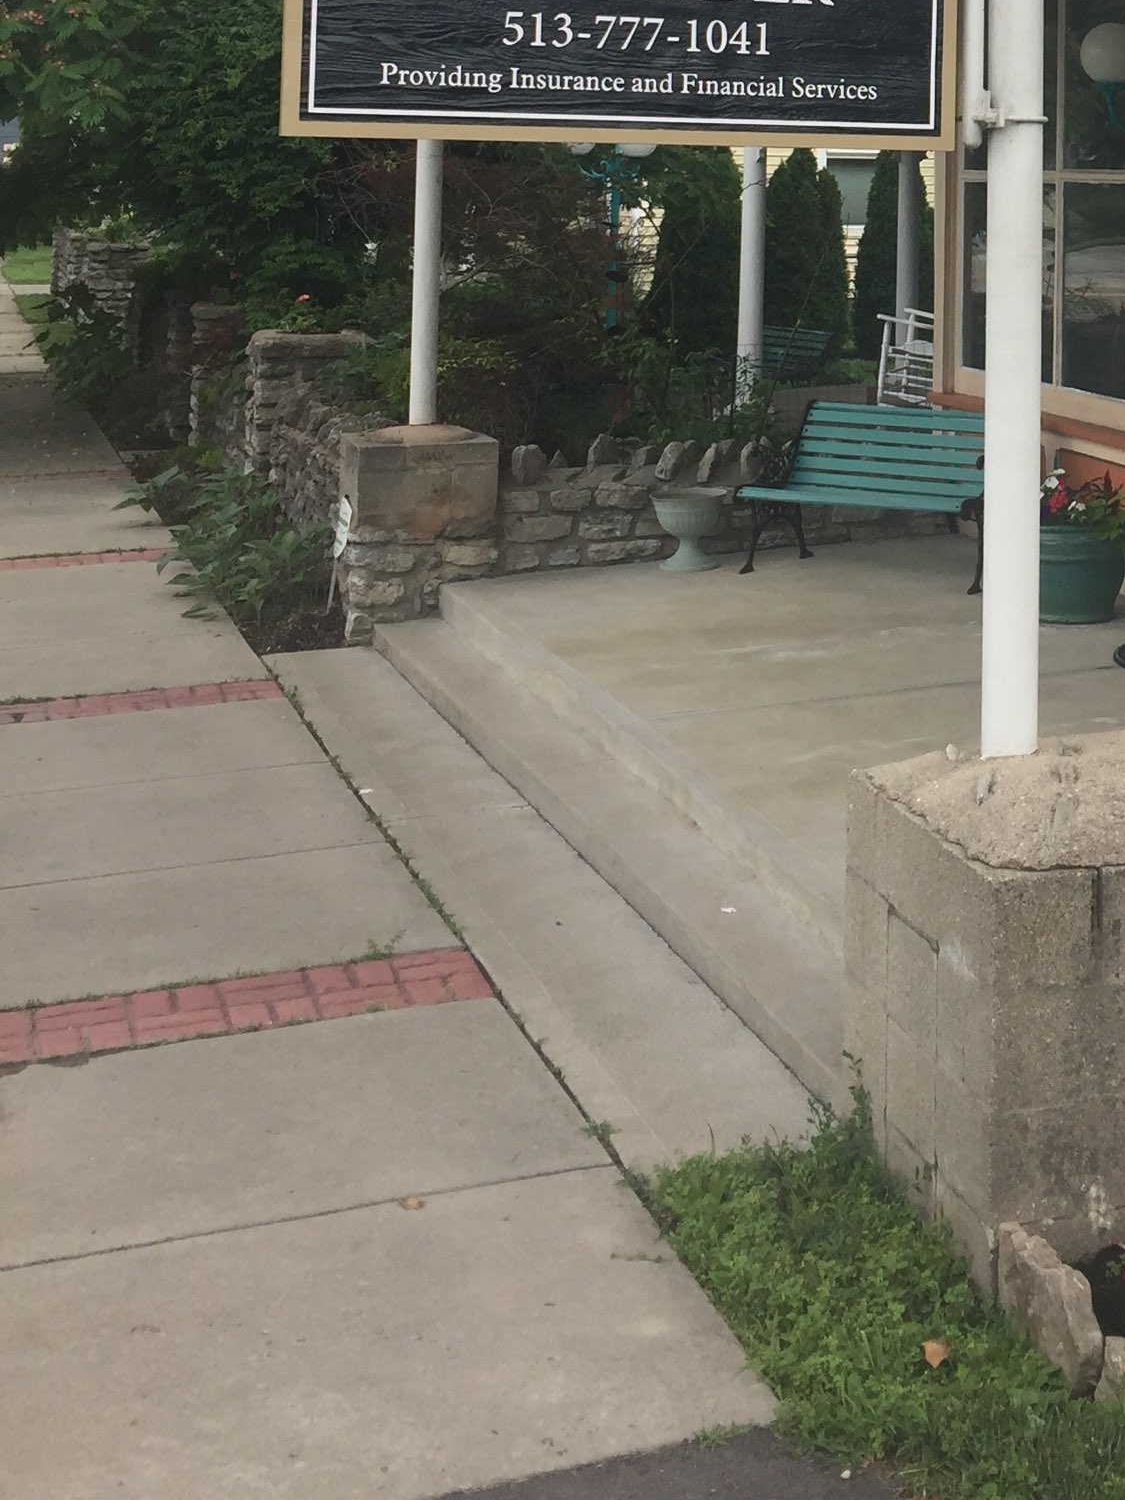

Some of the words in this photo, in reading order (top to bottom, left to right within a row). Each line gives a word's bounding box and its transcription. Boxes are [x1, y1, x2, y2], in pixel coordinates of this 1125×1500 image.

[503, 12, 770, 55] 513-777-1041
[380, 63, 503, 93] Providing
[510, 68, 625, 93] Insurance
[632, 72, 673, 94] and
[681, 73, 785, 97] Financial
[792, 77, 878, 100] Services
